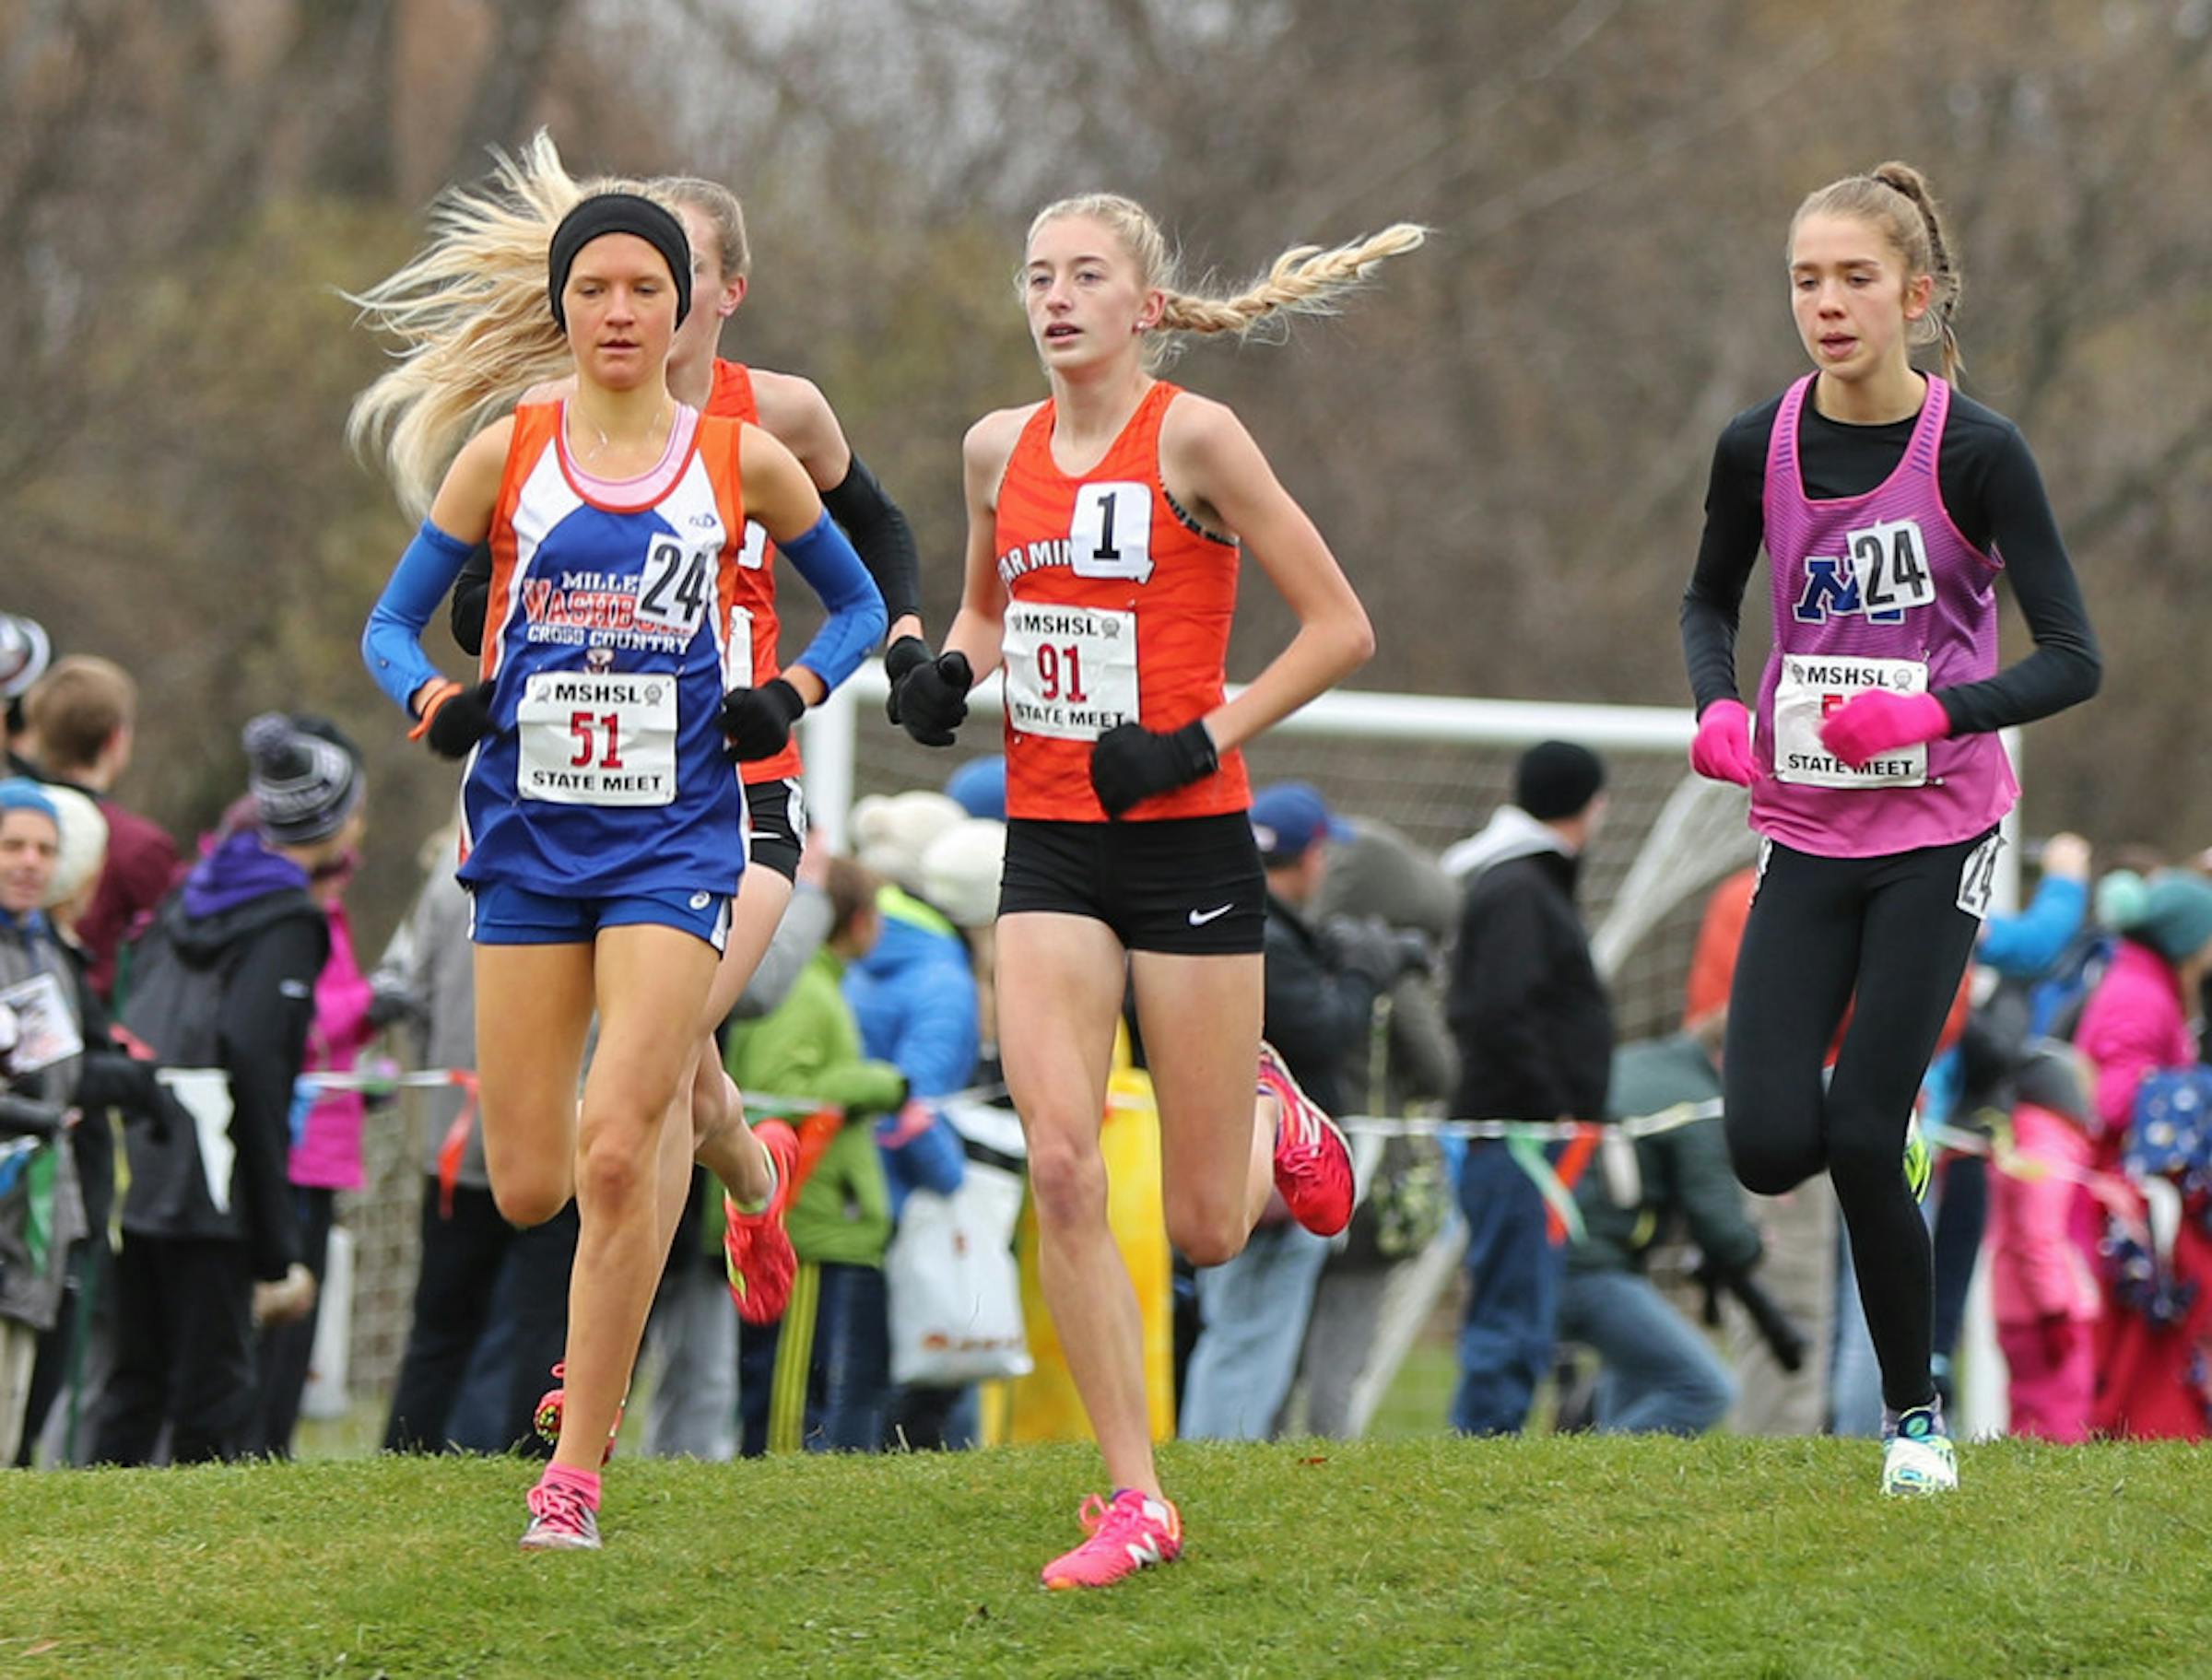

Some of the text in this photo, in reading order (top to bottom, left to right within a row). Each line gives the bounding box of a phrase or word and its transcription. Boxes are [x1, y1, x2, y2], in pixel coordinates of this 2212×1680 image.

[1092, 491, 1121, 561] 1
[561, 570, 639, 593] MILLE
[1854, 528, 1927, 606] 24
[641, 544, 708, 623] 24
[522, 579, 693, 637] WASHB
[527, 624, 693, 655] CROSS COUNTRY
[1025, 615, 1098, 636] MSHSL
[1037, 642, 1088, 703] 91
[1807, 665, 1889, 687] MSHSL
[556, 683, 641, 704] MSHSL
[1015, 702, 1124, 729] STATE MEET
[571, 711, 624, 769] 51
[1788, 753, 1846, 774] STATE
[533, 770, 662, 792] STATE MEET
